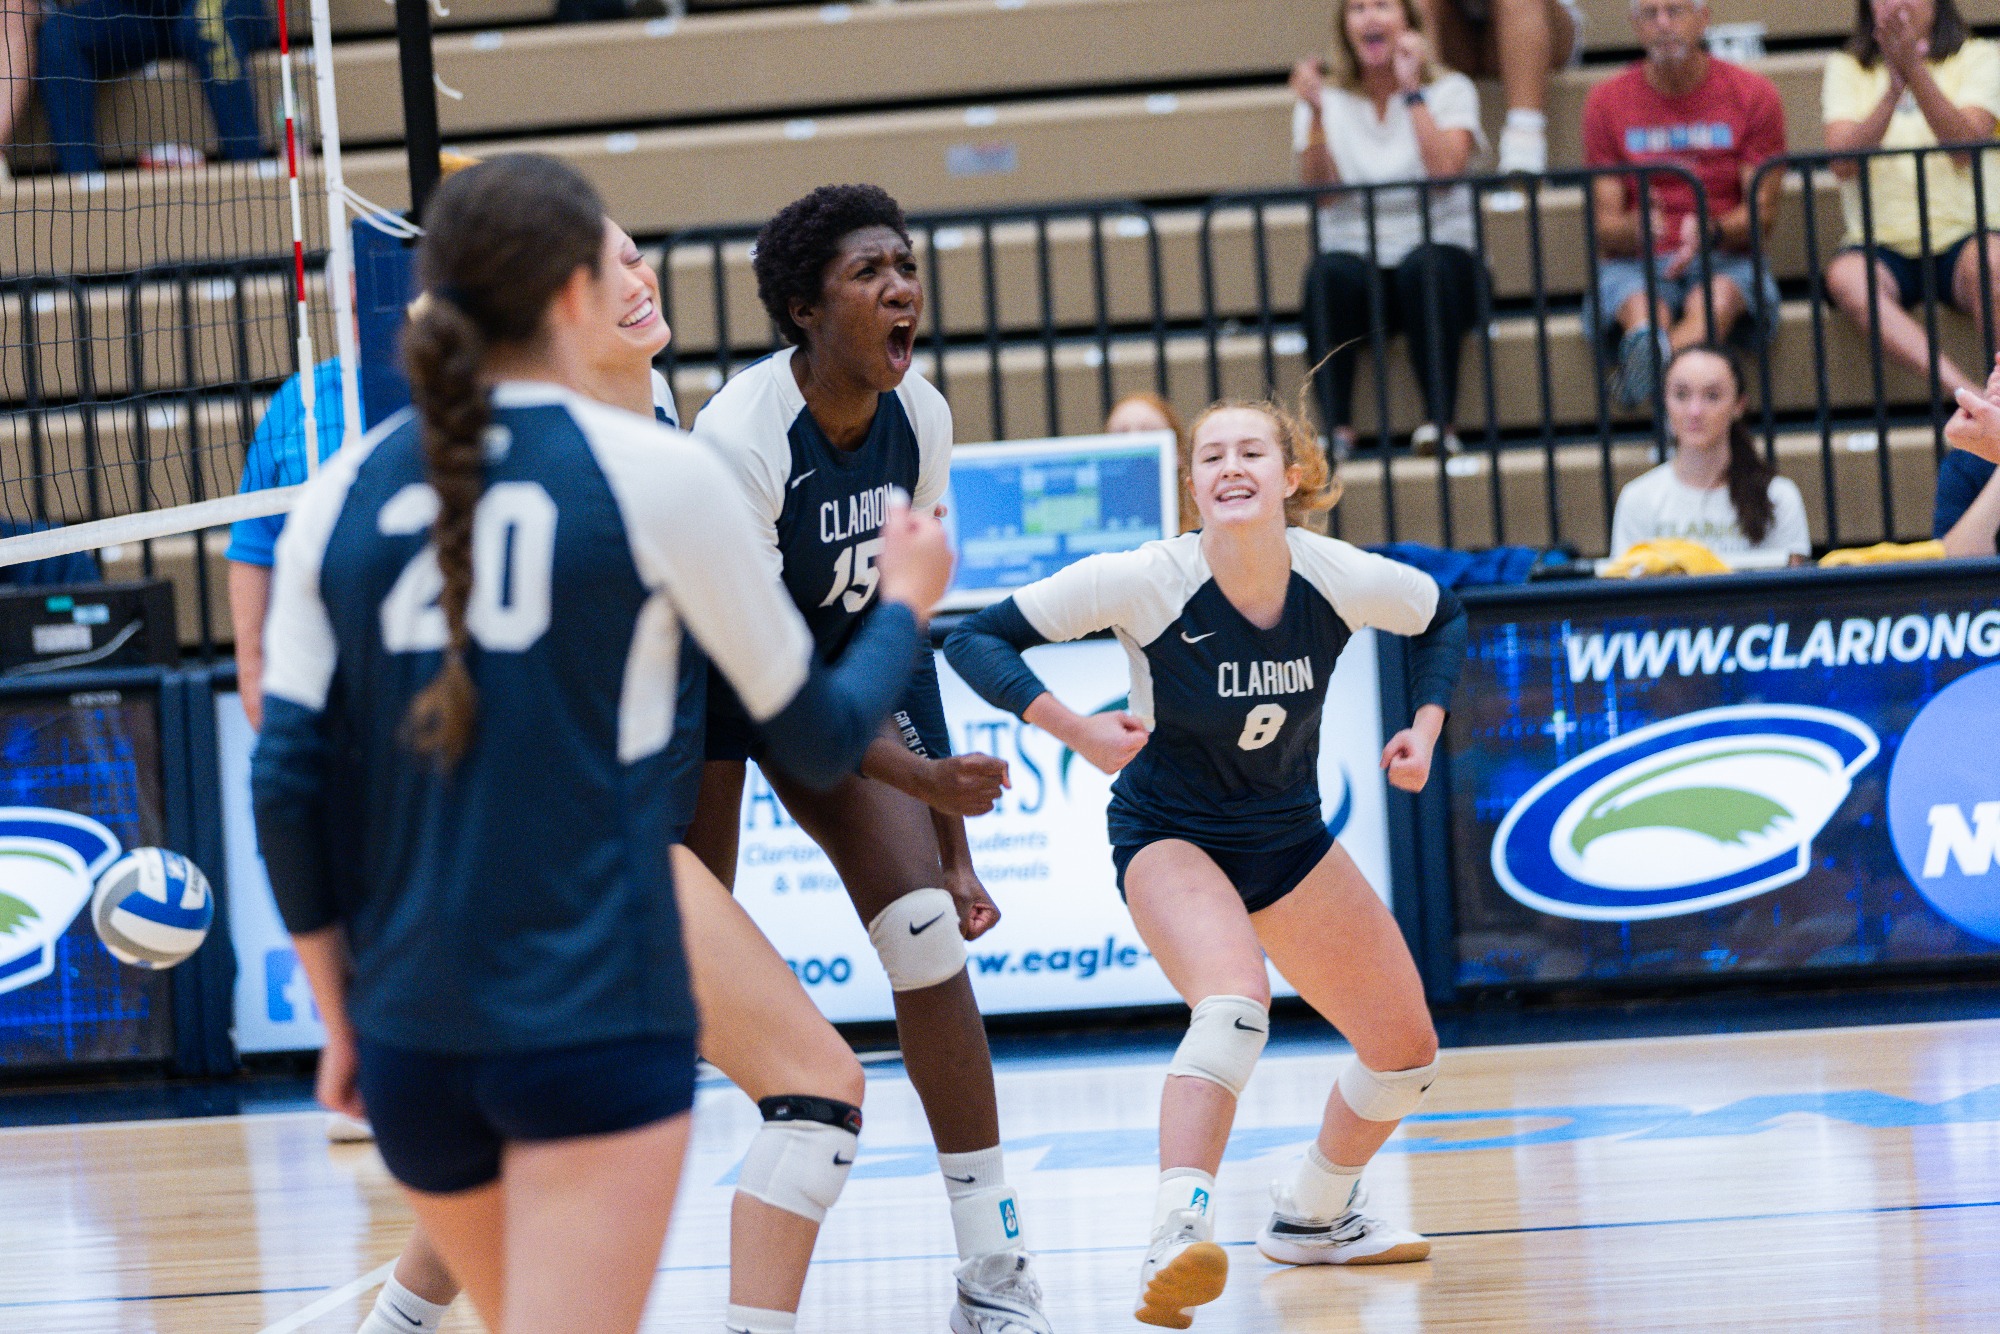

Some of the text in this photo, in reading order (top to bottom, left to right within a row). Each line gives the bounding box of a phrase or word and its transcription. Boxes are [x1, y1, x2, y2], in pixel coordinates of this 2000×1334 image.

[820, 482, 894, 543] CLARION
[378, 481, 559, 654] 20
[818, 537, 886, 613] 15
[1218, 656, 1314, 697] CLARION
[1237, 703, 1287, 751] 8
